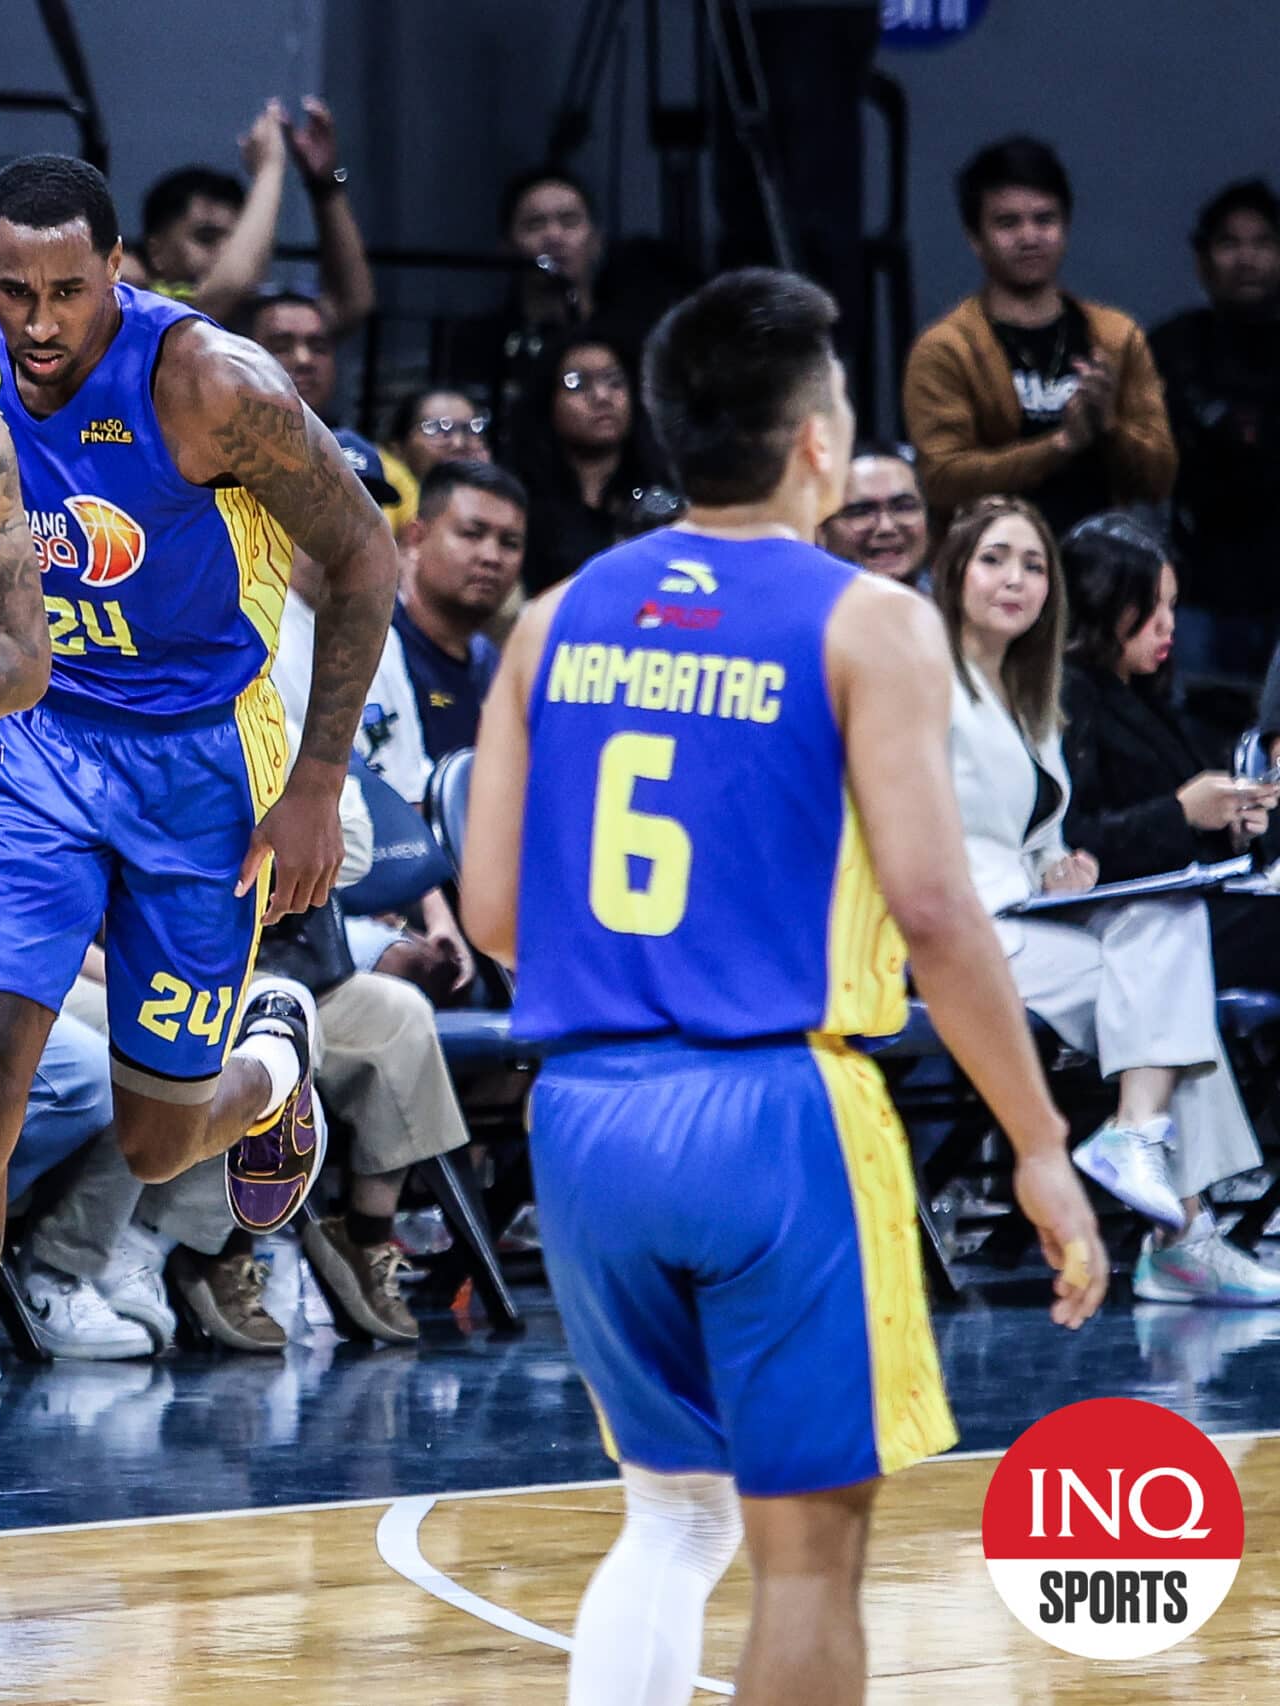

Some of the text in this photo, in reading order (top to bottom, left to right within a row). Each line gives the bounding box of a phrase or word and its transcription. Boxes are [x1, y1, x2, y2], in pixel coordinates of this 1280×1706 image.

[81, 430, 132, 444] FINALS
[43, 595, 139, 657] 24
[547, 642, 787, 724] NAMBATAC
[588, 730, 694, 938] 6
[137, 971, 233, 1046] 24
